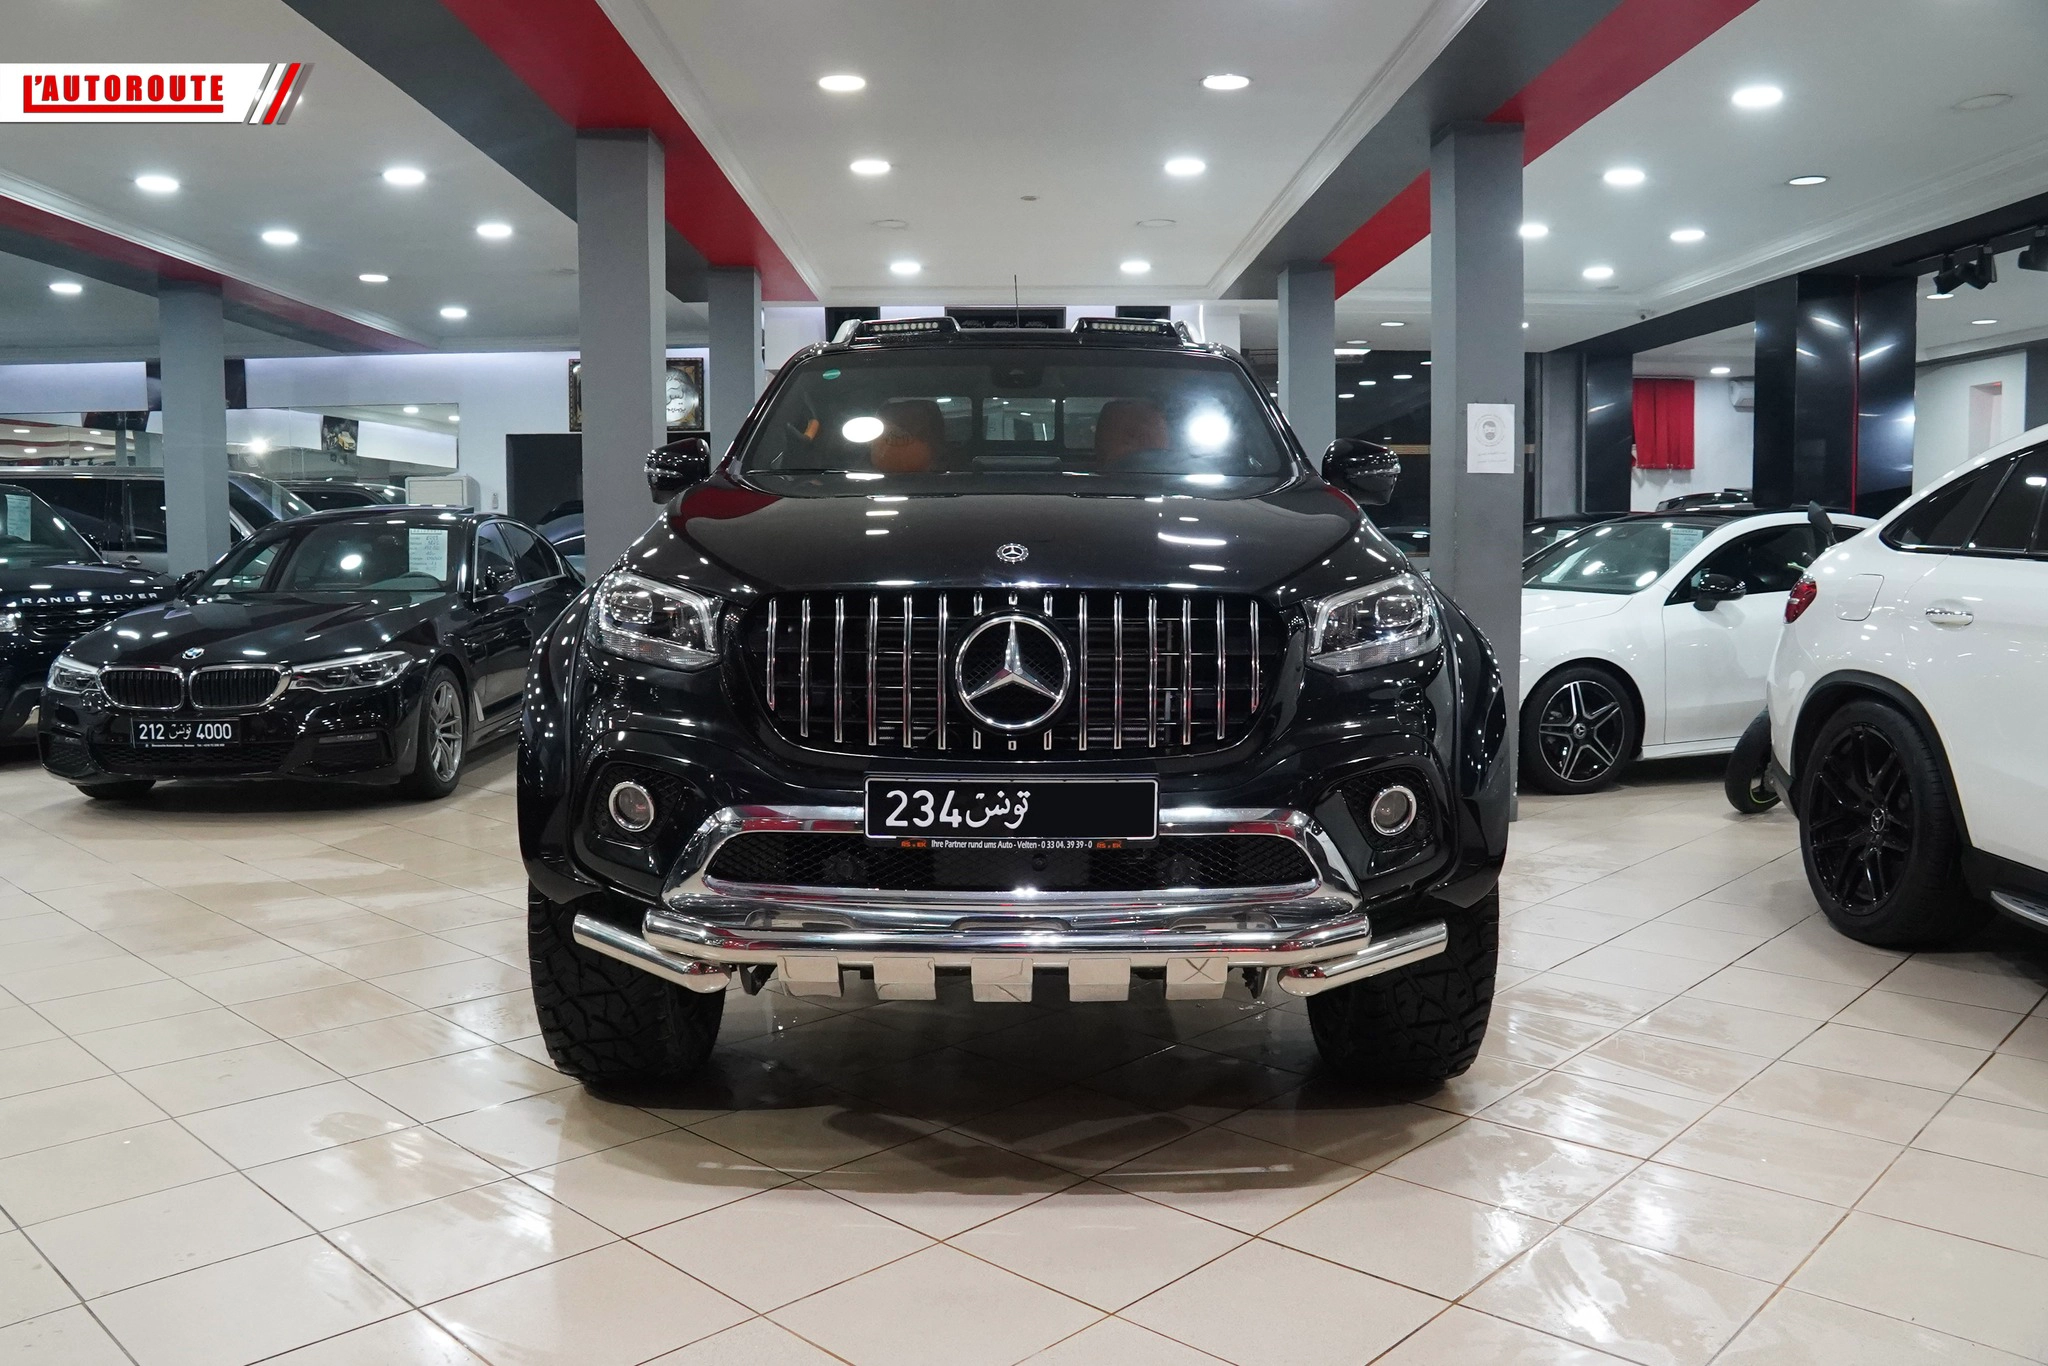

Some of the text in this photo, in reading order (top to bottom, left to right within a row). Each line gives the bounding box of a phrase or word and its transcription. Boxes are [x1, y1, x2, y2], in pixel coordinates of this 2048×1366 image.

[21, 592, 158, 604] RANGE ROVER
[139, 723, 165, 740] 212
[195, 723, 232, 740] 4000
[885, 789, 962, 828] 234
[931, 840, 944, 848] Ihre
[944, 840, 967, 849] Partner
[967, 840, 983, 849] rund
[983, 841, 997, 849] ums
[997, 840, 1013, 849] Auto
[1016, 840, 1038, 849] Velten
